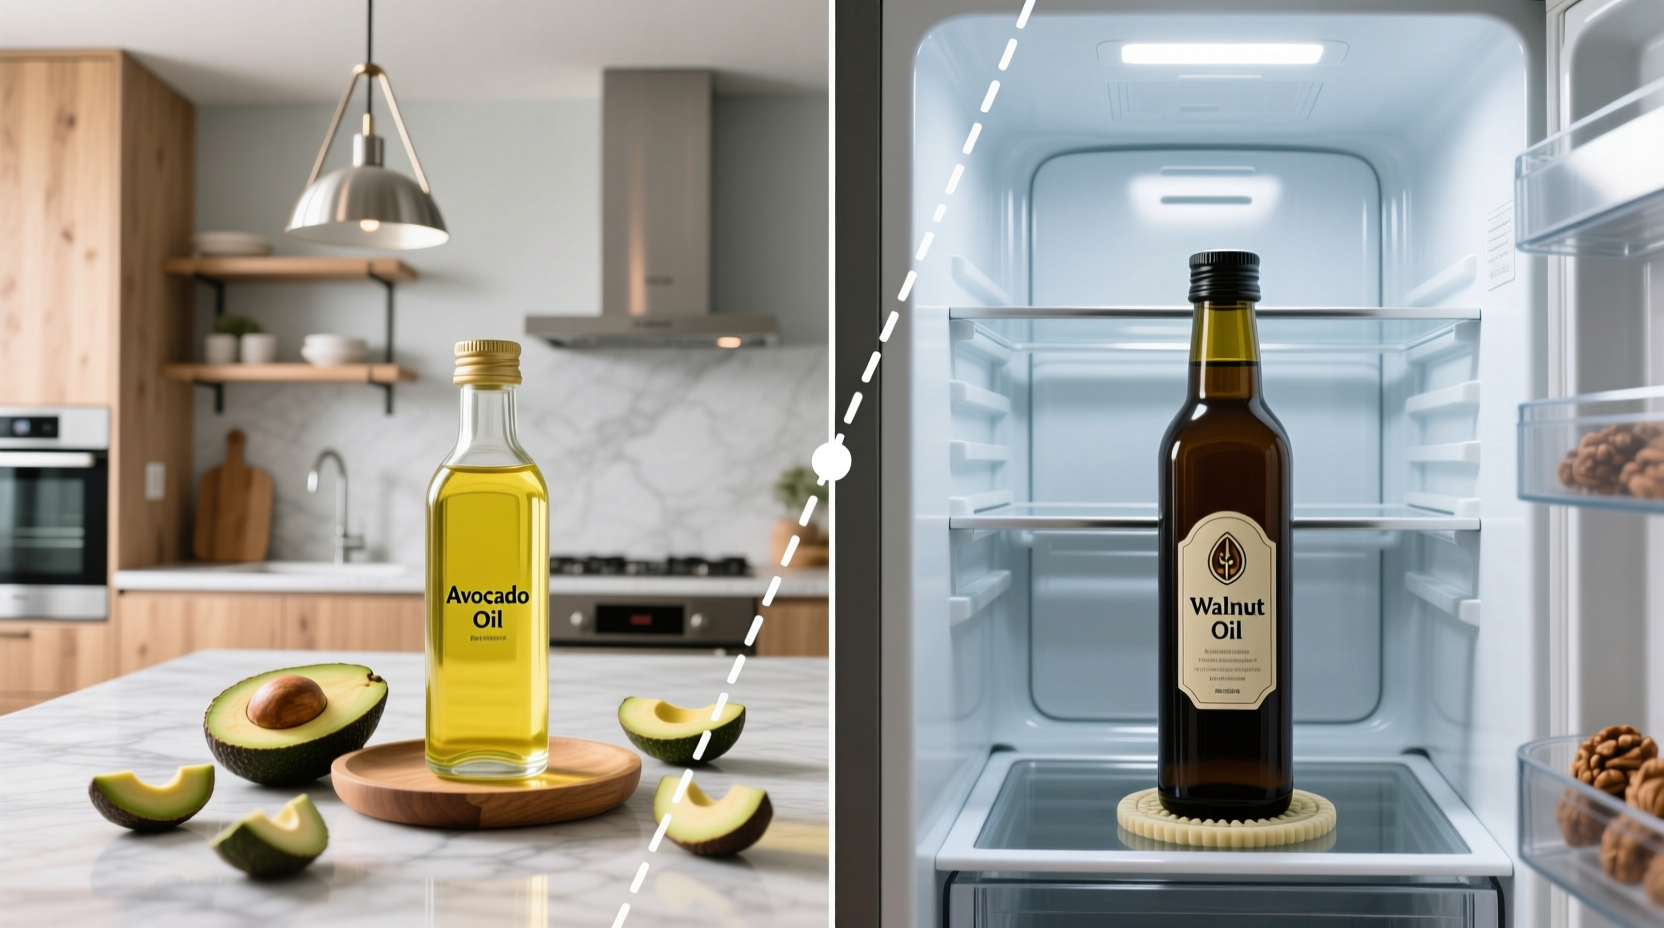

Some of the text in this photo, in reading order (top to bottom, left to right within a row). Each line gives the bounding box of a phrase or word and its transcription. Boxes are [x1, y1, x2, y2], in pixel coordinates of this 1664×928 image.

[446, 585, 529, 604] Avocado
[1190, 596, 1265, 615] Walnut
[473, 610, 502, 628] Oil
[1211, 620, 1242, 639] Oil
